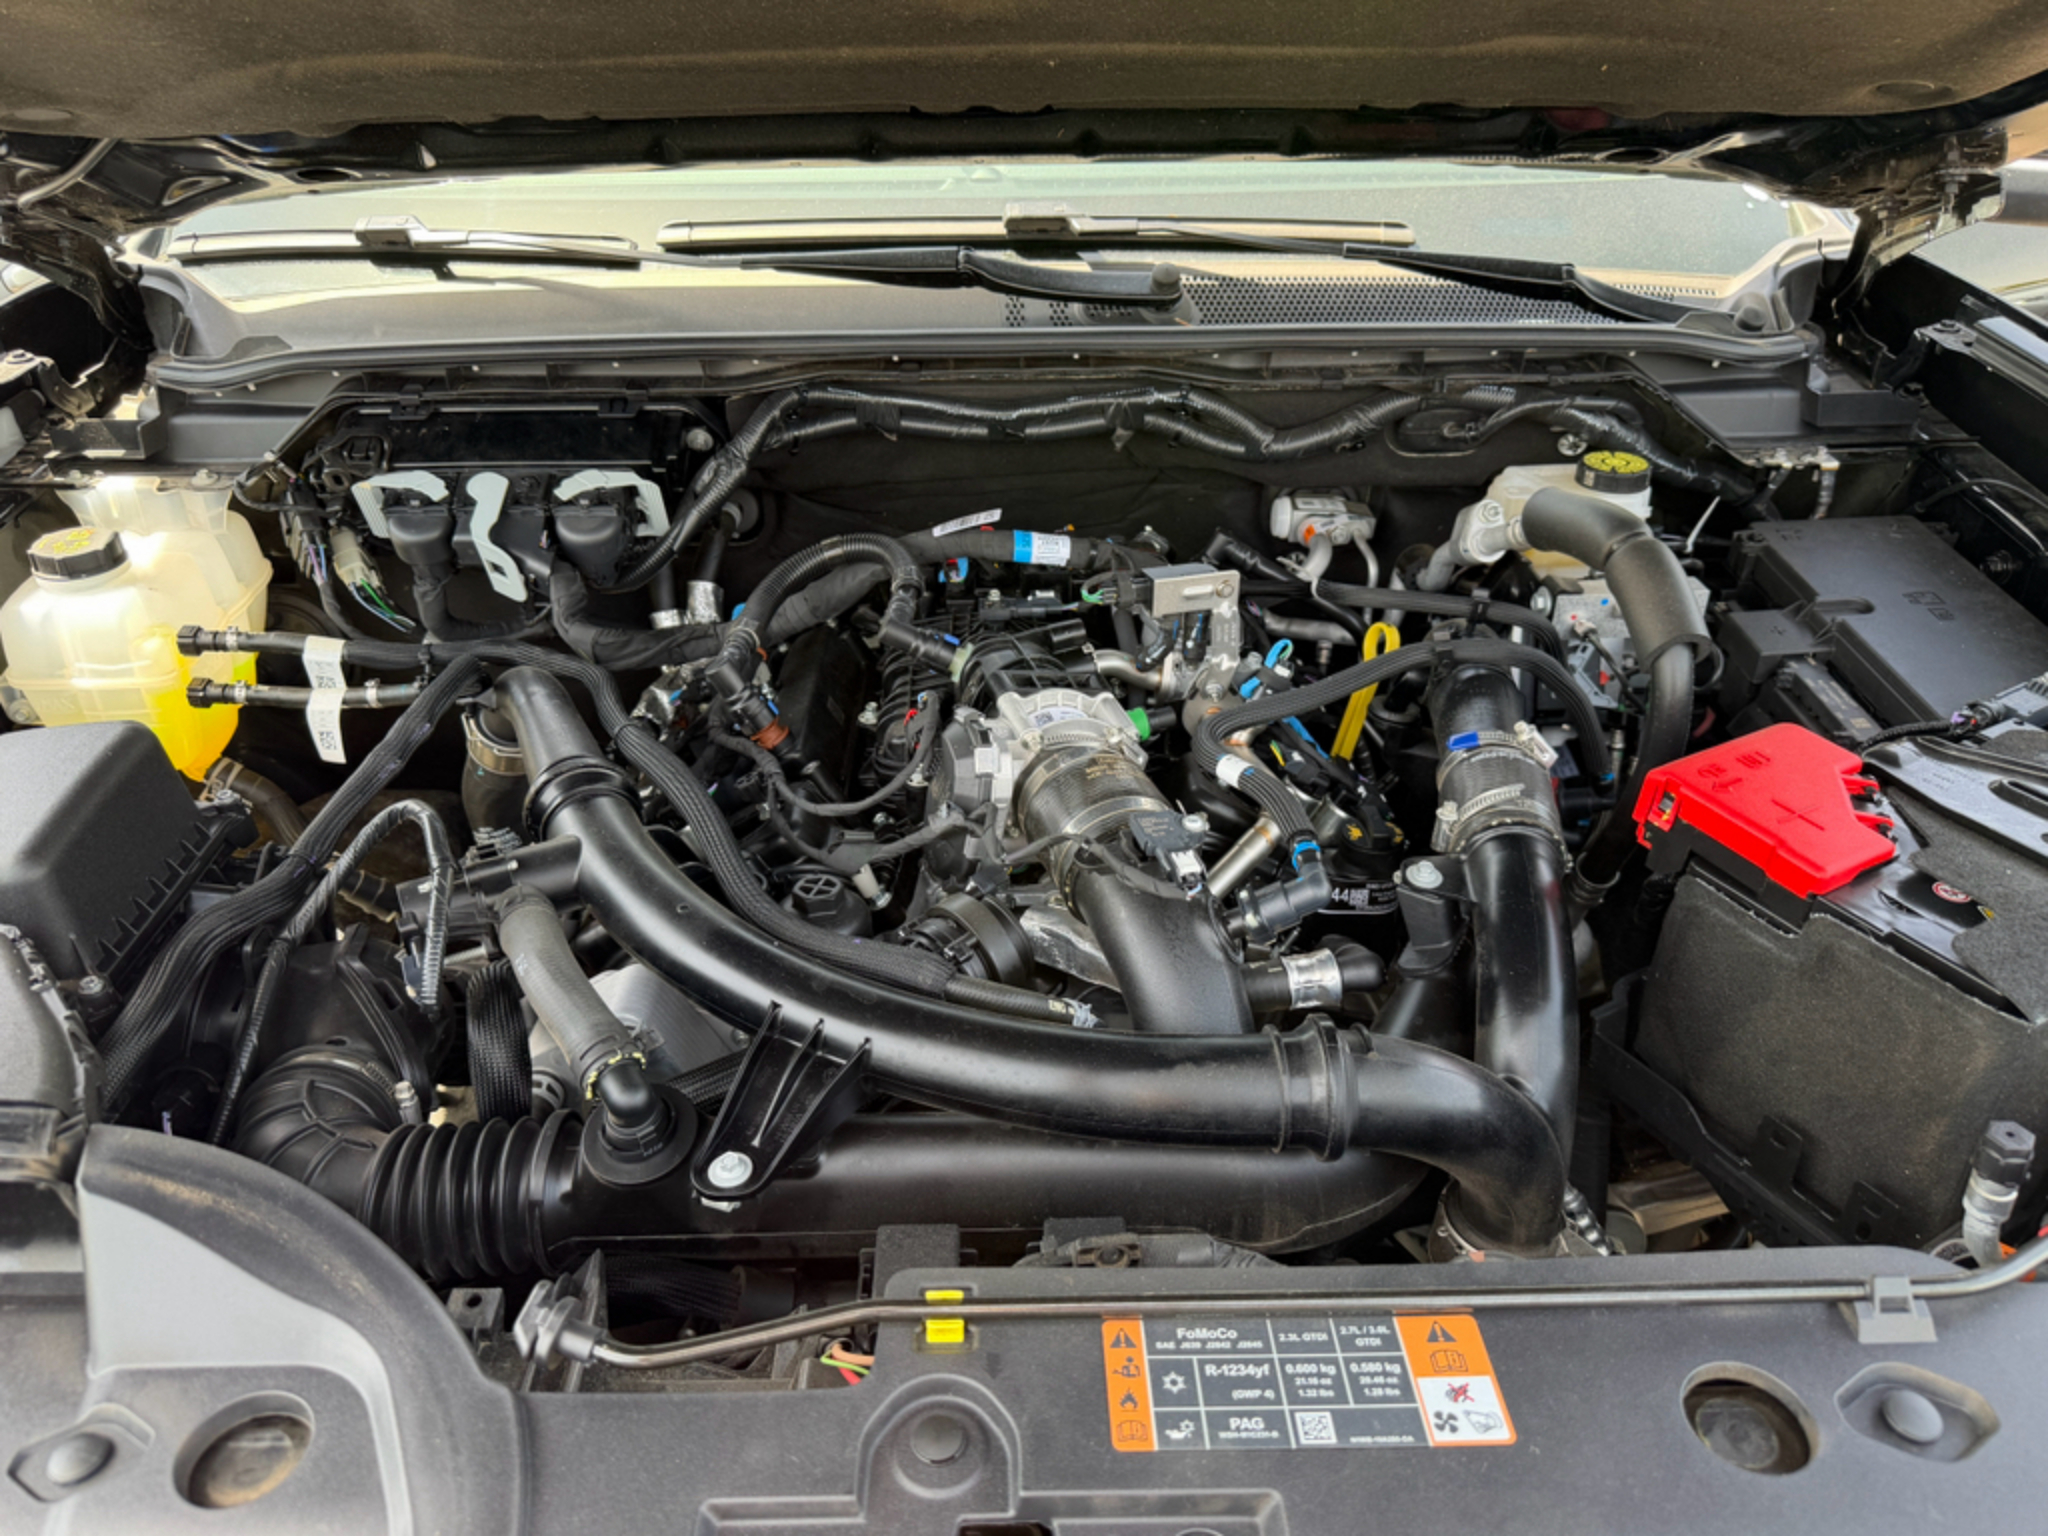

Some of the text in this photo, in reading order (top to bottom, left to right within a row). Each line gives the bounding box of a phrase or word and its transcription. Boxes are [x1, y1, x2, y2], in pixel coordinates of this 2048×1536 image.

[1176, 1327, 1238, 1339] FoMoCo
[1204, 1363, 1271, 1379] R-1234yf
[1285, 1362, 1337, 1376] 0.600 kg
[1384, 1361, 1402, 1375] kg
[1229, 1416, 1265, 1430] PAG
